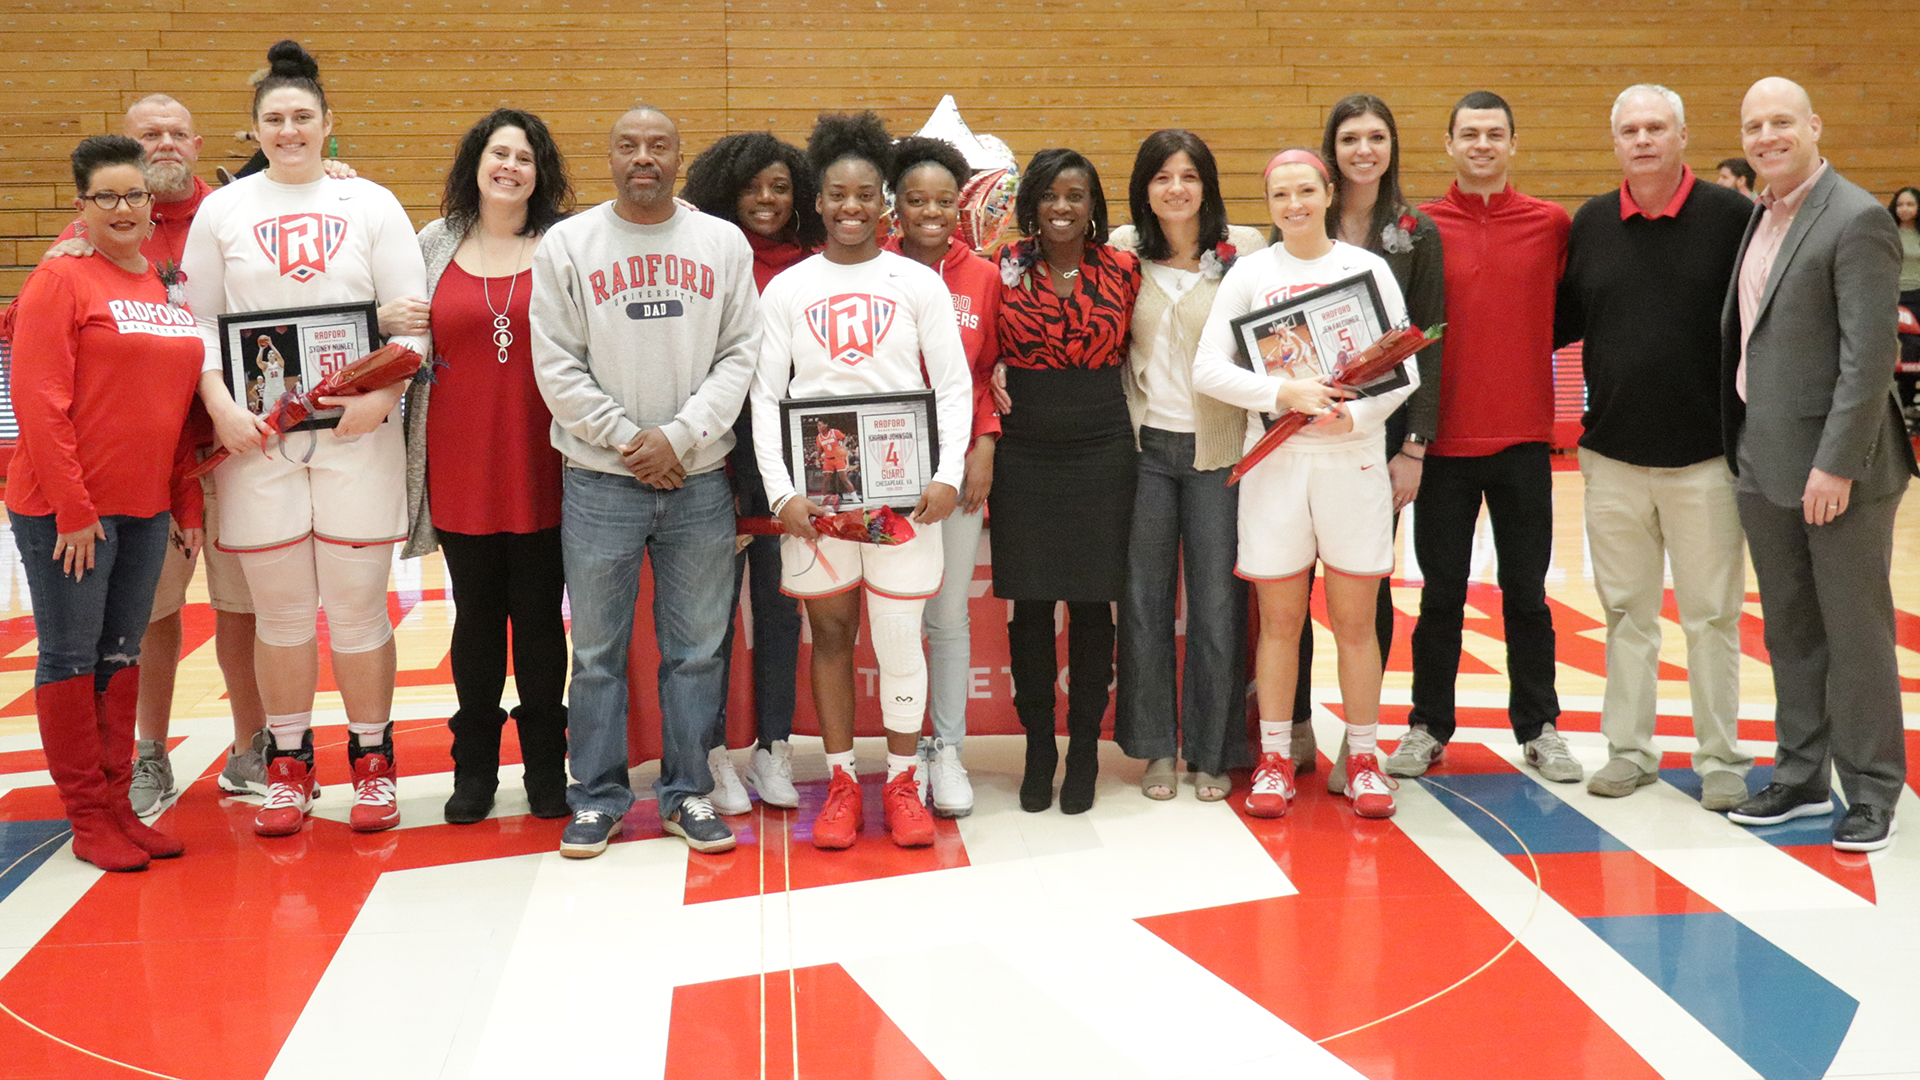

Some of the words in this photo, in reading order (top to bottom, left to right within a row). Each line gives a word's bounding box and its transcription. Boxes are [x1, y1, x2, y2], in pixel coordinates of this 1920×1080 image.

[588, 254, 714, 306] RADFORD
[614, 289, 694, 307] UNIVERSITY
[108, 299, 195, 326] RADFORD
[643, 303, 667, 317] DAD
[1321, 304, 1352, 321] RADFORD
[122, 324, 200, 336] BASKETBALL
[314, 329, 347, 340] RADFORD
[1337, 327, 1355, 353] 5
[309, 344, 331, 354] SYDNEY
[320, 351, 347, 378] 50
[874, 418, 906, 429] RADFORD
[885, 441, 899, 467] 4
[881, 468, 905, 480] GUARD
